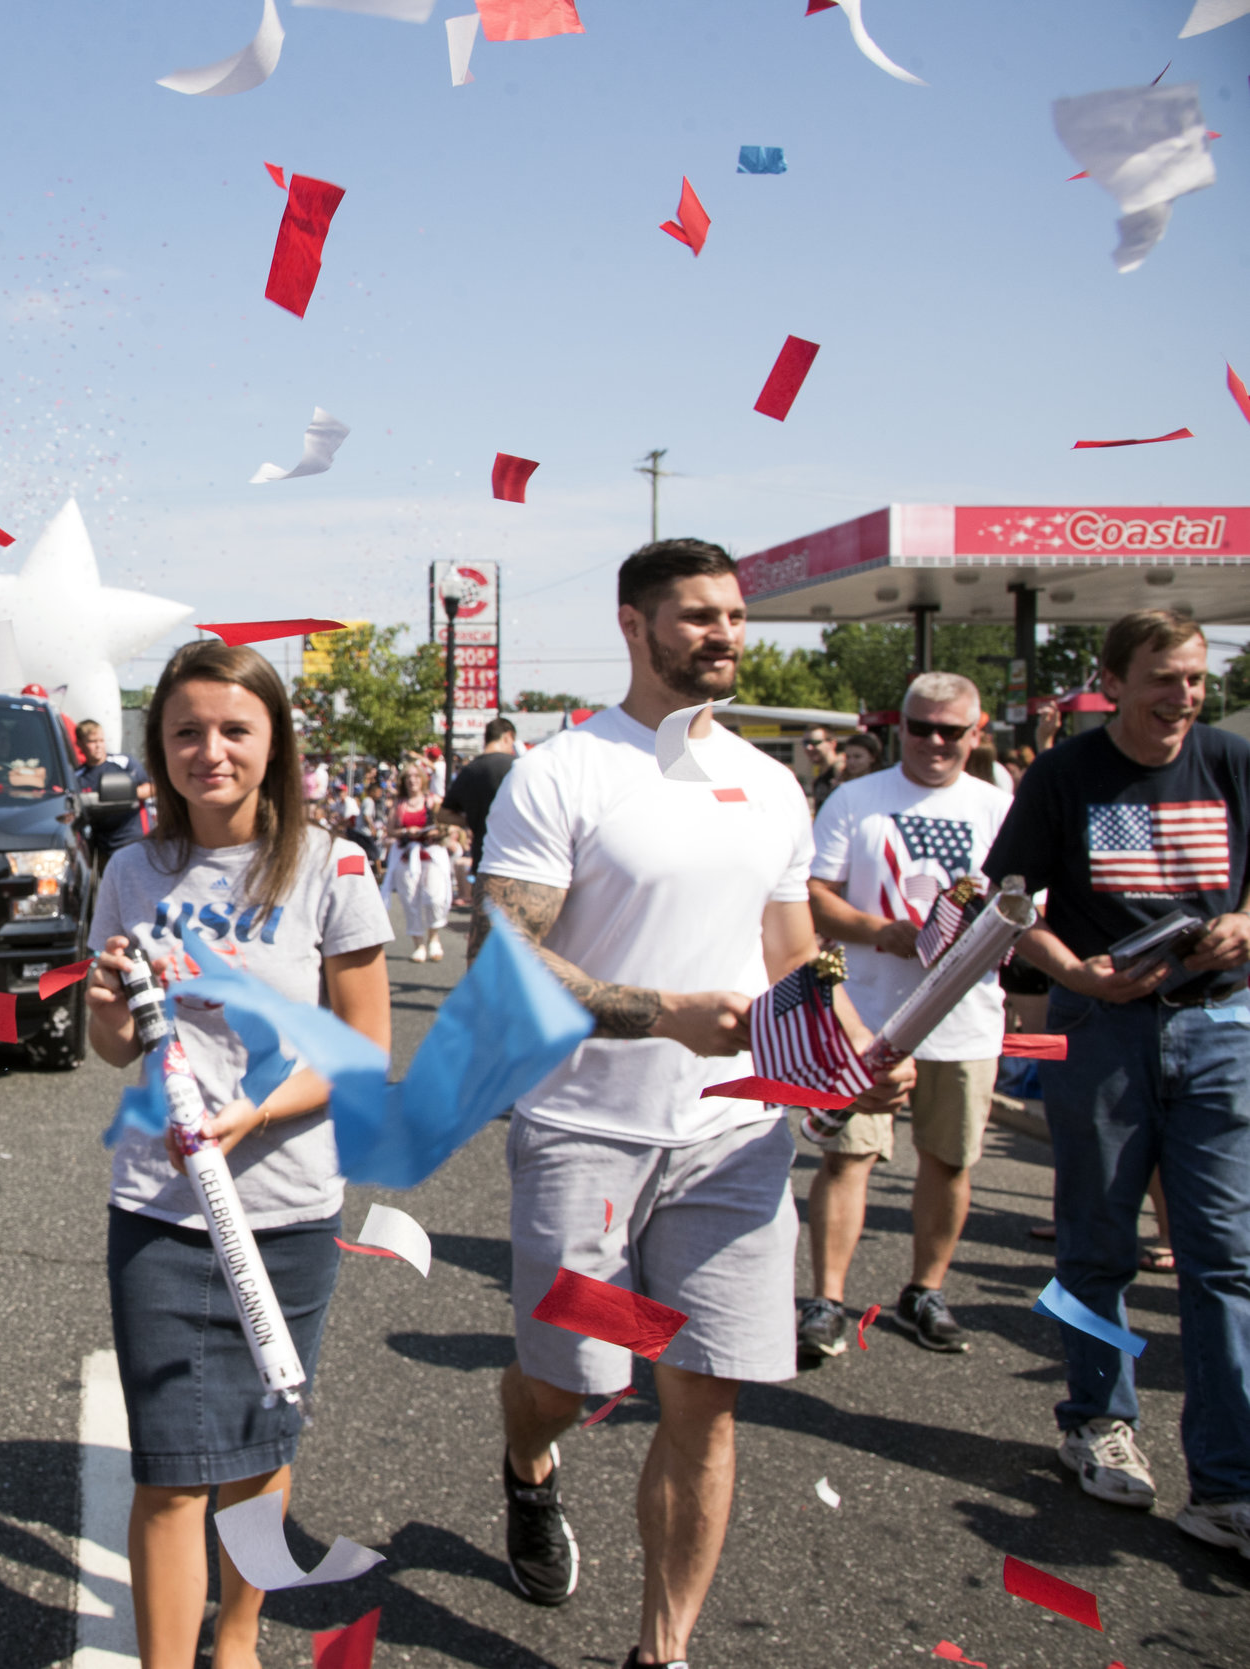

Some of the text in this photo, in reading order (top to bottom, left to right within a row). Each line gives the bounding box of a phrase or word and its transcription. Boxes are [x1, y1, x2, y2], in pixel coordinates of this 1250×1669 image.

[1066, 510, 1226, 550] Coastal
[198, 1168, 249, 1276] CELEBRATION
[237, 1277, 276, 1348] CANNON
